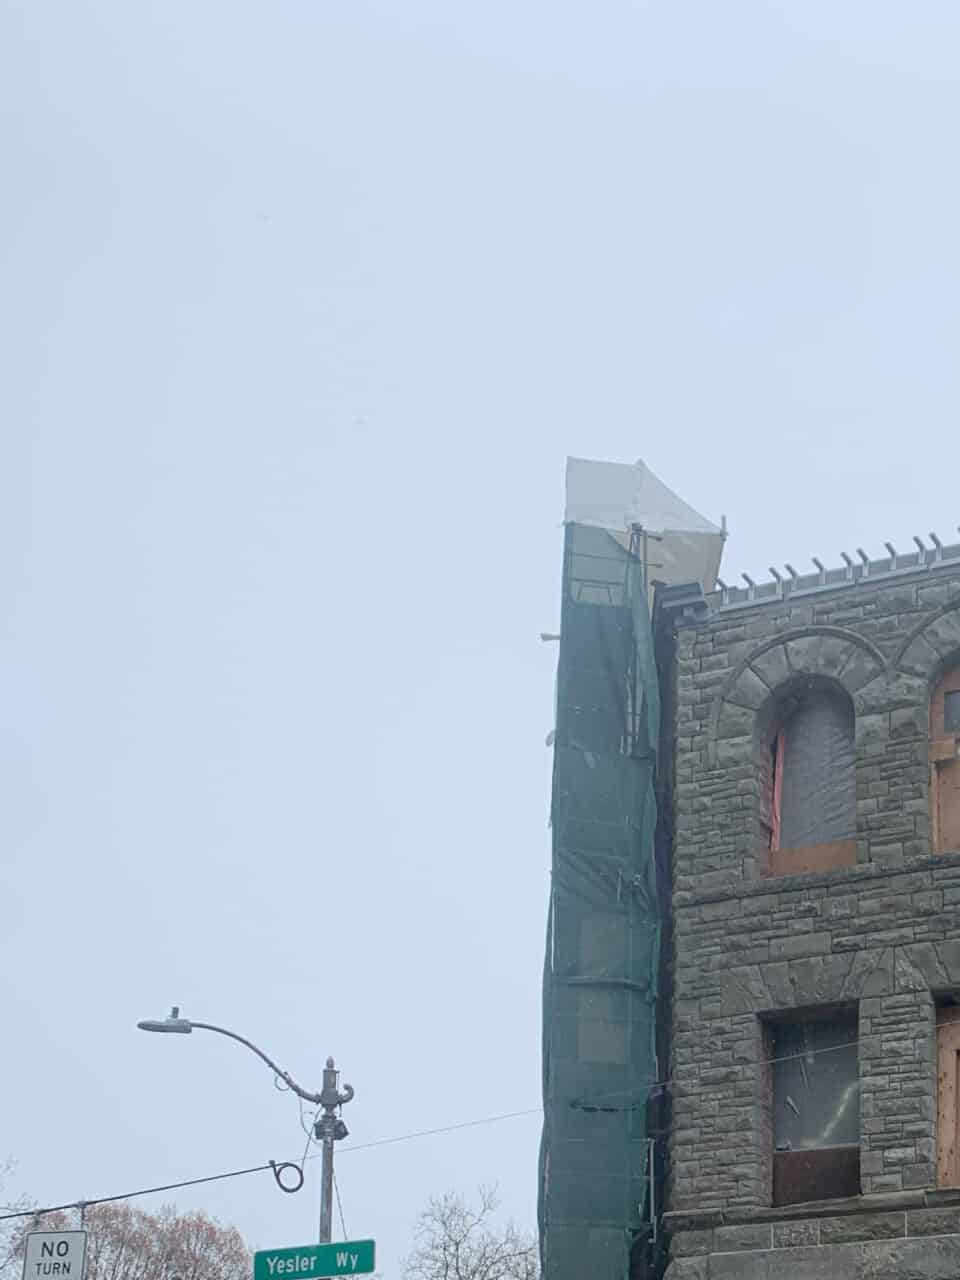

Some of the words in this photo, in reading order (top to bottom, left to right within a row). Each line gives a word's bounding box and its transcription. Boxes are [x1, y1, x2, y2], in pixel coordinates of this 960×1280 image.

[41, 1241, 69, 1257] NO
[35, 1261, 71, 1276] TURN
[266, 1255, 318, 1275] Yesler
[336, 1251, 359, 1270] Wy
